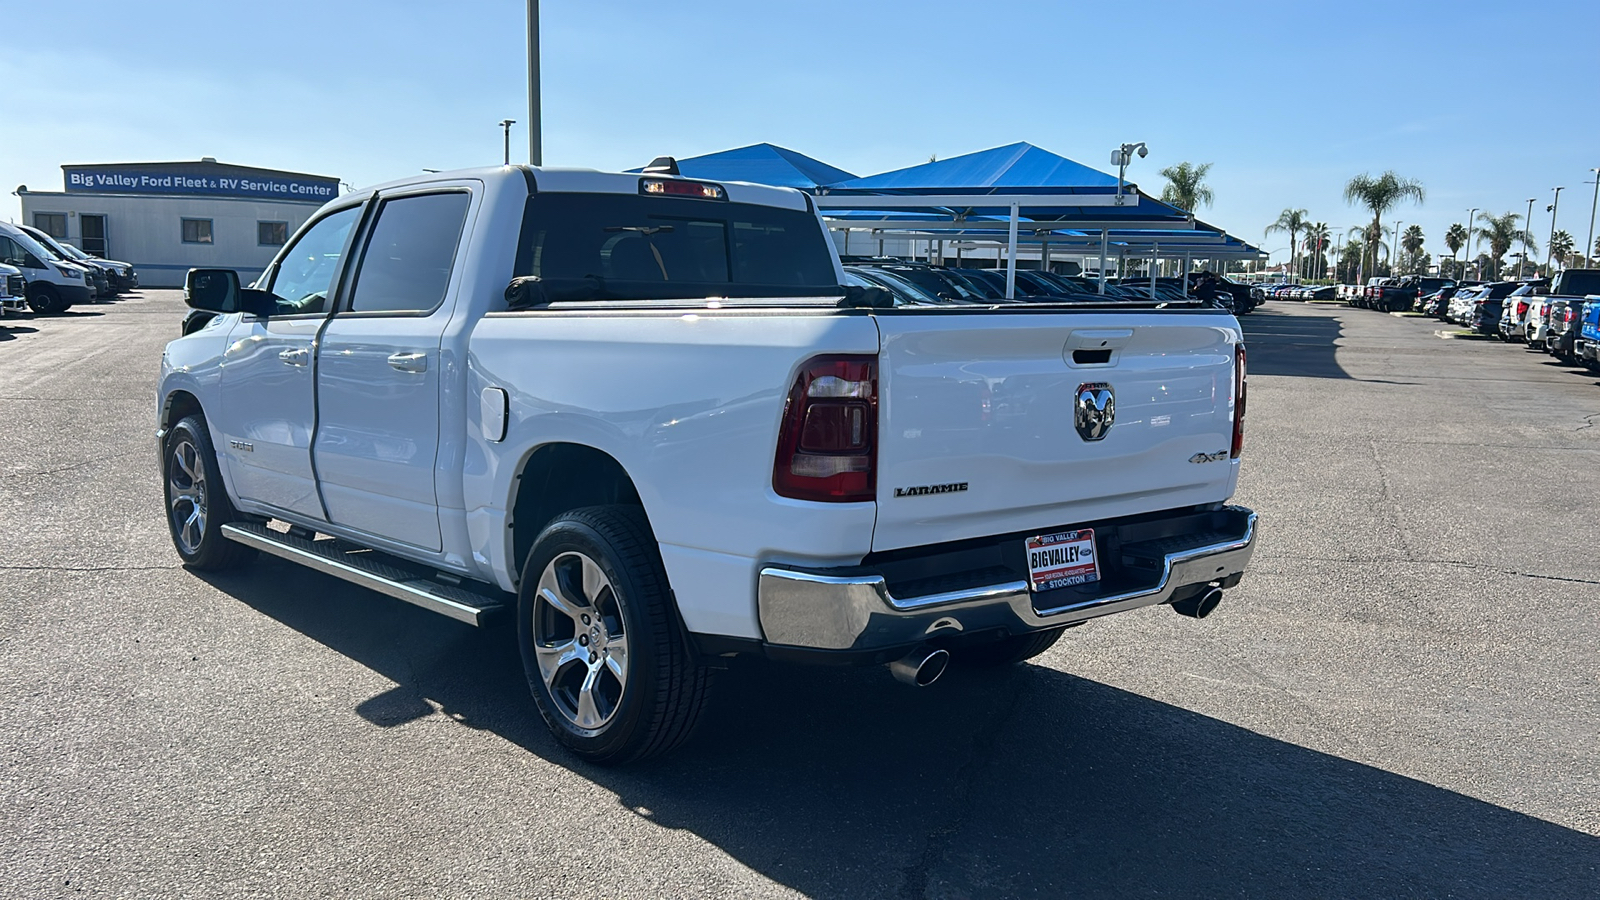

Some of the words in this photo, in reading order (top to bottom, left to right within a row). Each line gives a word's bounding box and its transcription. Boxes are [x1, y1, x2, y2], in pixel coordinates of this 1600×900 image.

[71, 173, 94, 187] Big
[96, 174, 139, 188] Valley
[141, 175, 172, 187] Ford
[174, 177, 208, 188] Fleet
[210, 180, 217, 189] &
[220, 178, 238, 189] RV
[241, 179, 288, 193] Service
[290, 183, 331, 195] Center
[893, 482, 968, 498] LARAMIE
[1042, 536, 1055, 544] BIG
[1055, 532, 1078, 542] VALLEY
[1031, 545, 1080, 569] BIGVALLEY
[1049, 575, 1086, 589] STOCKTON
